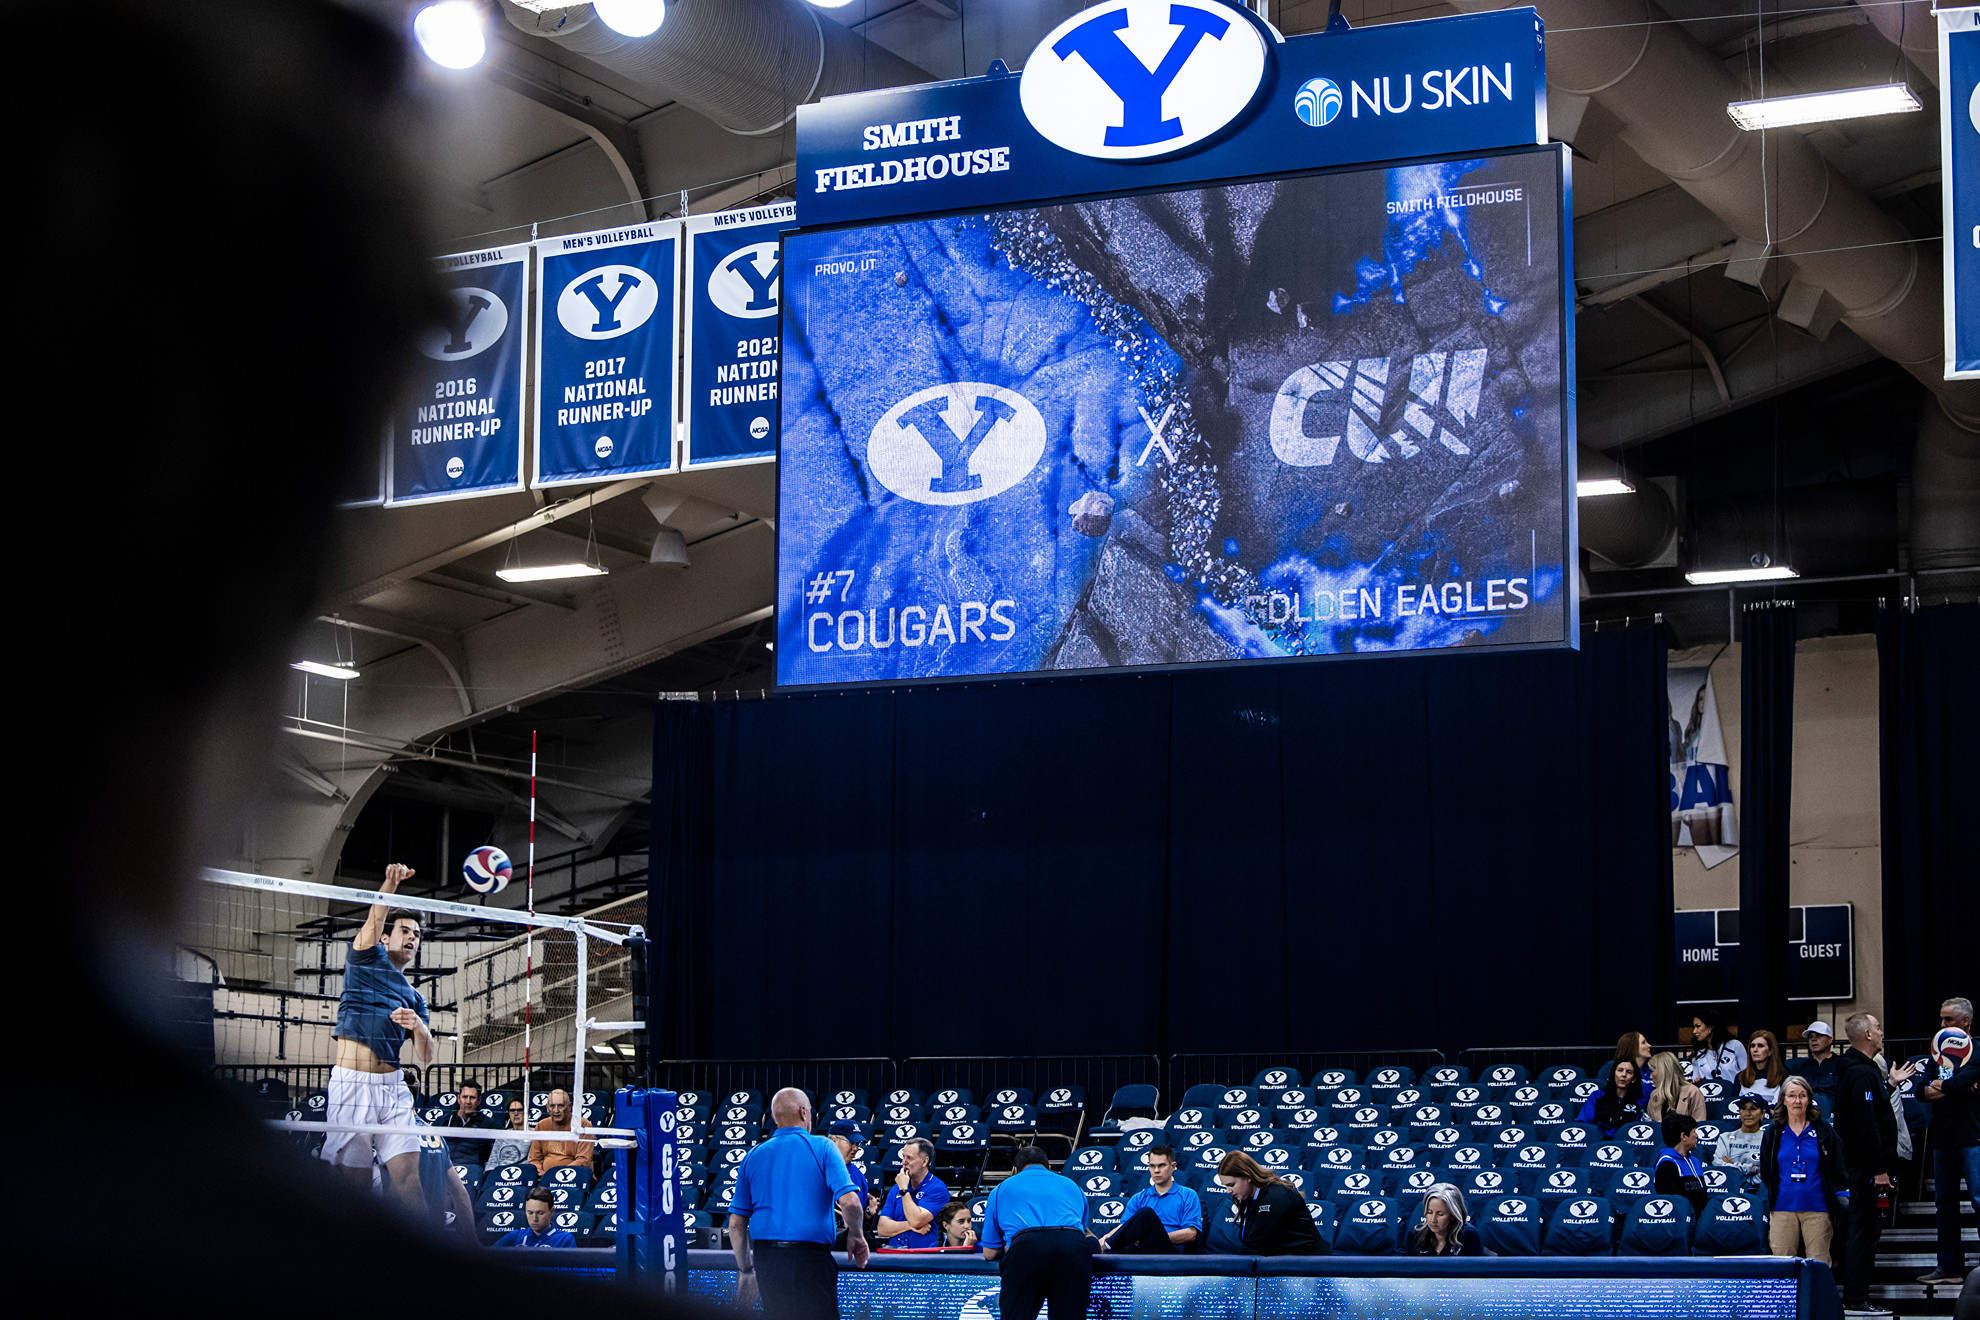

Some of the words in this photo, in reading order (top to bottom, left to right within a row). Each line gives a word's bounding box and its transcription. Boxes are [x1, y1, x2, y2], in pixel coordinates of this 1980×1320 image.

[1051, 3, 1231, 147] Y
[1351, 73, 1413, 118] NU
[1421, 62, 1513, 110] SKIN
[863, 115, 962, 151] SMITH
[815, 146, 1010, 193] FIELDHOUSE
[1386, 197, 1433, 215] SMITH
[1437, 188, 1523, 209] FIELDHOUSE
[714, 212, 746, 226] MEN'S
[749, 205, 797, 221] VOLLEYB
[563, 236, 593, 250] MEN'S
[595, 227, 654, 245] VOLLEYBALL
[815, 261, 858, 277] PROVO,
[861, 258, 877, 272] UT
[573, 272, 642, 332] Y
[585, 357, 626, 379] 2017
[717, 359, 778, 384] NATION
[435, 377, 477, 399] 2016
[564, 377, 647, 404] NATIONAL
[710, 381, 778, 407] RUNNER
[418, 397, 496, 424] NATIONAL
[558, 398, 653, 427] RUNNER-UP
[411, 417, 501, 446] RUNNER-UP
[751, 426, 769, 434] NCAA
[1136, 402, 1179, 467] X
[596, 445, 613, 454] NCAA
[895, 395, 1018, 494] Y
[447, 465, 465, 474] NCAA
[805, 569, 855, 605] #7
[1397, 577, 1529, 618] EAGLES
[808, 599, 1017, 653] COUGARS
[1682, 948, 1720, 962] HOME
[1799, 943, 1842, 958] GUEST
[1947, 1038, 1963, 1047] NCAA
